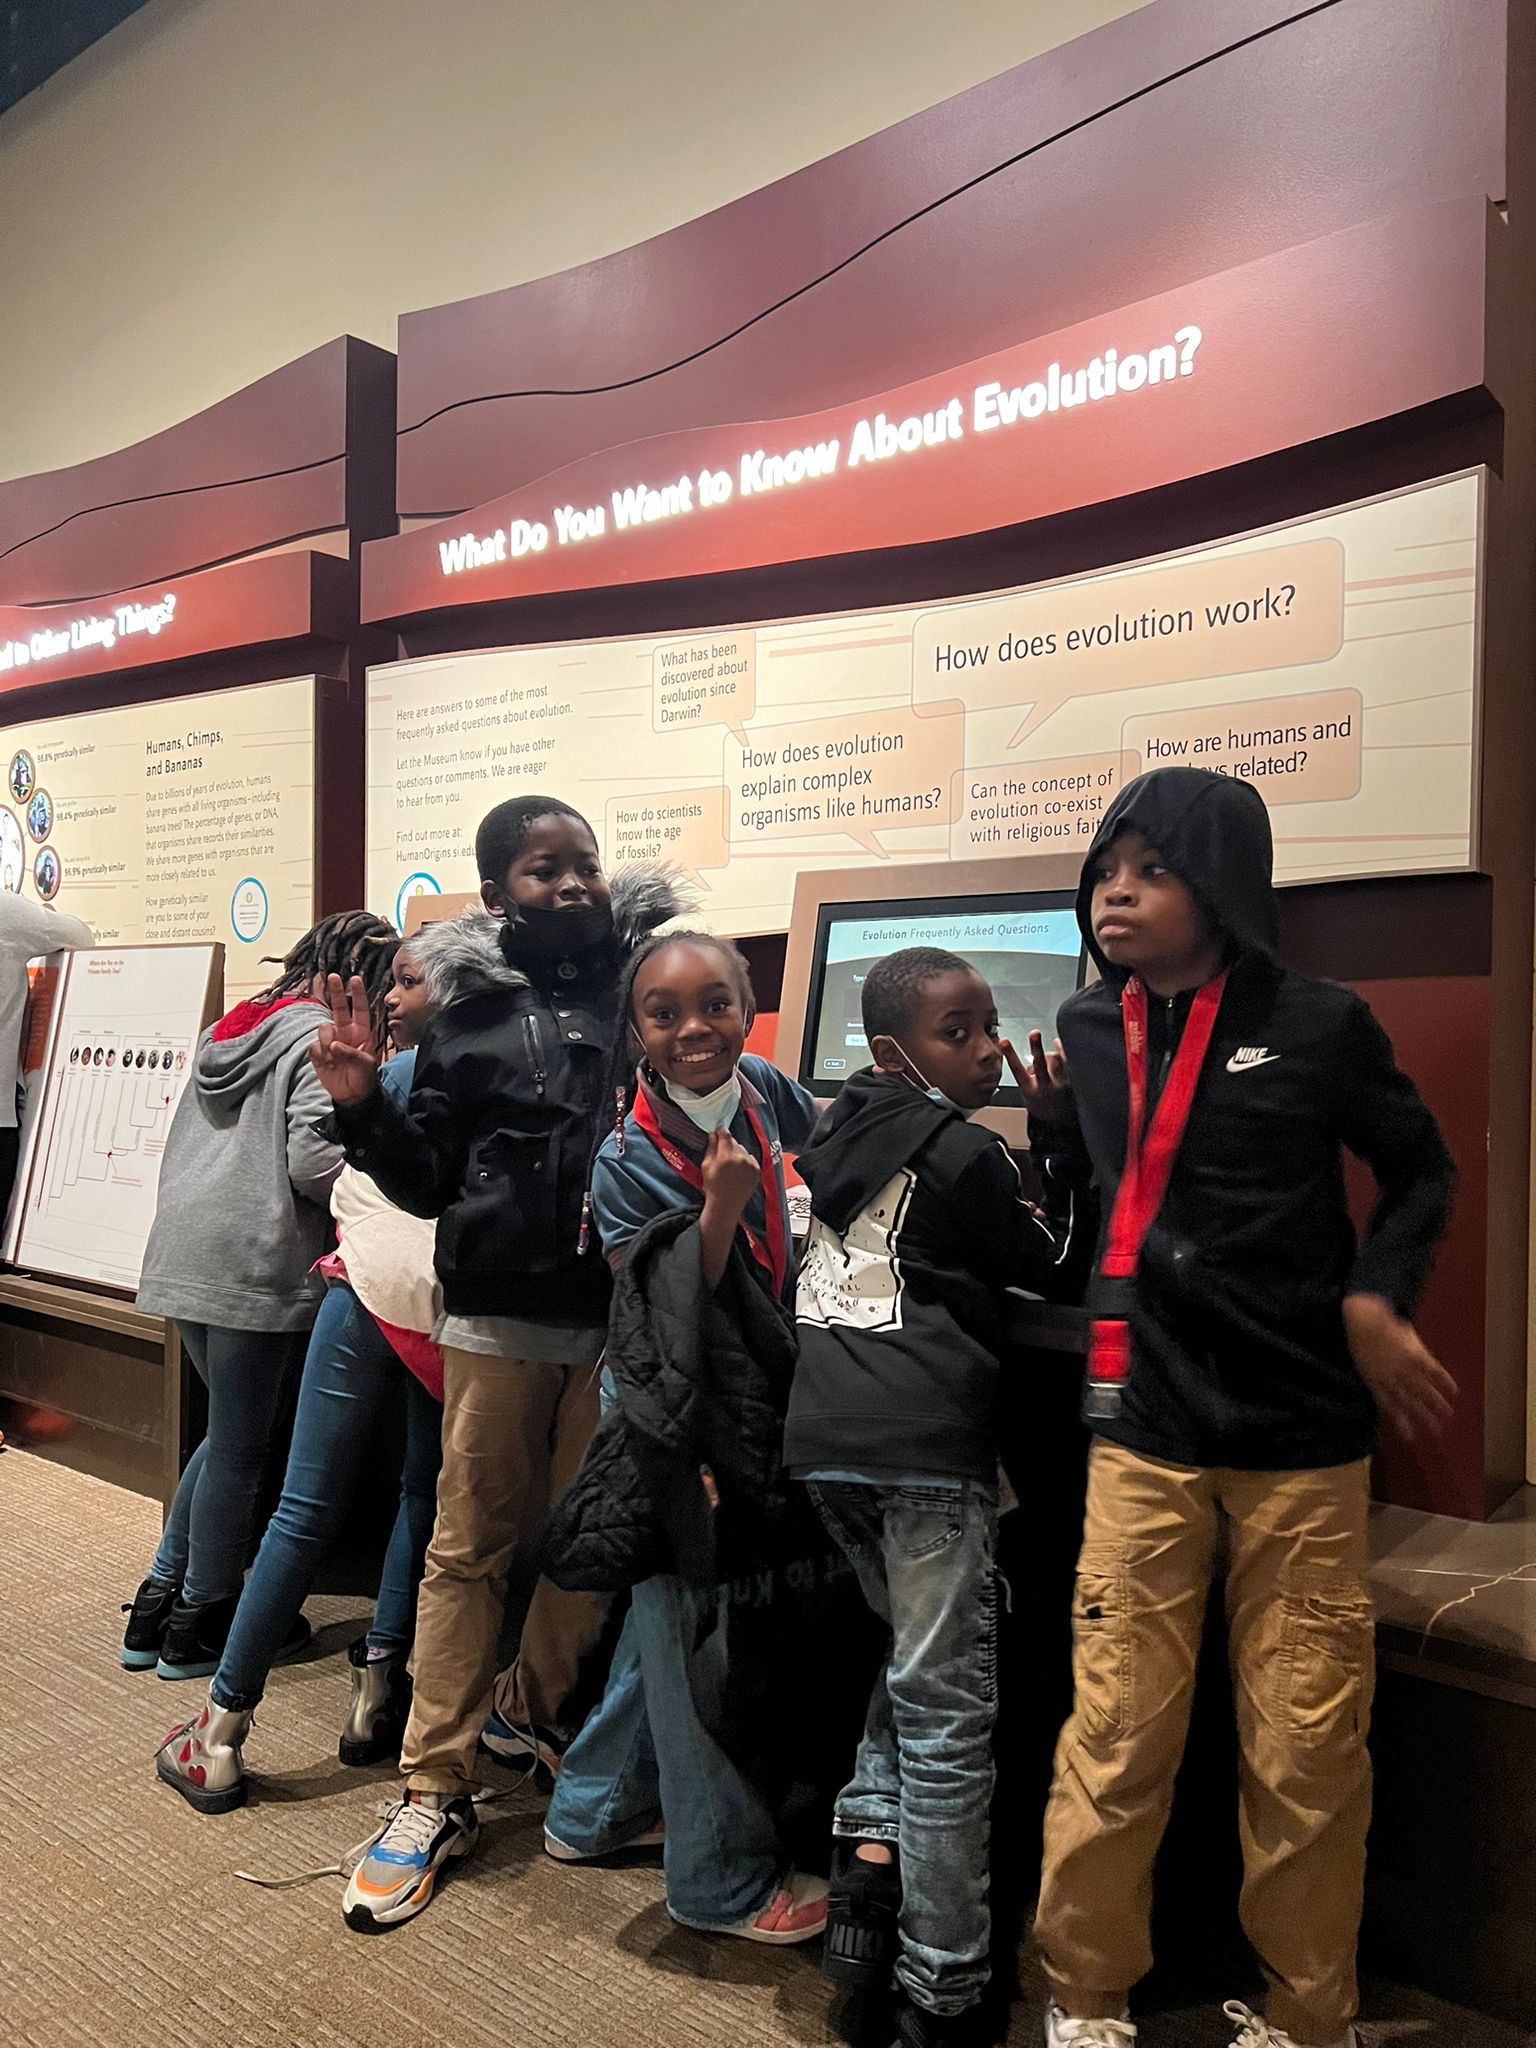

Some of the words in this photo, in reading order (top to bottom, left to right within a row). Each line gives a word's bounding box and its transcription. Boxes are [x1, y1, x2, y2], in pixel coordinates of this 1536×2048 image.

[438, 528, 506, 575] What
[510, 518, 548, 557] Do
[553, 504, 605, 544] You
[611, 475, 692, 529] Want
[698, 467, 732, 507] to
[740, 439, 839, 497] Know
[848, 398, 963, 467] About
[974, 325, 1202, 432] Evolution?
[116, 593, 177, 635] Things?
[936, 644, 989, 672] How
[998, 633, 1056, 662] does
[1067, 609, 1192, 650] evolution
[1205, 585, 1295, 628] work?
[661, 652, 688, 667] What
[691, 648, 708, 662] has
[712, 644, 736, 658] been
[661, 663, 714, 686] discovered
[717, 659, 748, 677] about
[397, 709, 414, 722] Here
[416, 708, 428, 718] are
[430, 702, 463, 715] answers
[465, 699, 473, 710] to
[475, 695, 497, 708] some
[500, 689, 508, 703] of
[510, 689, 524, 702] the
[526, 685, 548, 699] most
[661, 686, 706, 704] evolution
[710, 682, 736, 697] since
[397, 727, 434, 742] frequently
[436, 719, 459, 734] asked
[461, 715, 500, 732] questions
[503, 710, 528, 724] about
[530, 703, 573, 719] evolution.
[662, 704, 702, 723] Darwin?
[146, 739, 184, 755] Humans,
[187, 731, 223, 747] Chimps,
[1148, 738, 1188, 758] How
[1194, 736, 1222, 753] are
[1228, 727, 1306, 749] humans
[1313, 715, 1350, 740] and
[397, 758, 408, 770] Let
[409, 756, 422, 768] the
[424, 753, 458, 766] Museum
[460, 749, 482, 761] know
[485, 745, 490, 758] if
[492, 746, 507, 760] you
[510, 742, 530, 754] have
[532, 737, 555, 751] other
[743, 749, 776, 768] How
[782, 743, 819, 764] does
[826, 732, 903, 758] evolution
[146, 760, 162, 776] and
[165, 757, 202, 773] Bananas
[396, 775, 433, 792] questions
[434, 775, 444, 784] or
[445, 768, 489, 783] comments.
[491, 764, 505, 777] We
[508, 765, 521, 775] are
[523, 761, 547, 775] eager
[1234, 751, 1307, 778] related?
[742, 774, 796, 801] explain
[803, 765, 872, 793] complex
[971, 783, 996, 799] Can
[1004, 779, 1026, 796] the
[1032, 773, 1092, 793] concept
[1098, 768, 1114, 786] of
[396, 798, 404, 808] to
[406, 795, 423, 807] hear
[425, 793, 443, 805] from
[445, 793, 462, 806] you.
[617, 810, 638, 824] How
[641, 808, 654, 821] do
[657, 803, 702, 820] scientists
[741, 803, 820, 830] organisms
[827, 797, 855, 818] like
[862, 787, 941, 815] humans?
[971, 801, 1038, 821] evolution
[1044, 795, 1102, 814] co-exist
[396, 829, 413, 844] Find
[415, 830, 428, 841] out
[430, 829, 450, 840] more
[452, 827, 462, 838] at:
[616, 828, 642, 841] know
[646, 825, 661, 839] the
[664, 827, 681, 841] age
[970, 825, 1000, 842] with
[1008, 822, 1070, 842] religious
[1077, 817, 1102, 835] fait
[616, 846, 626, 860] of
[628, 843, 661, 863] fossils?
[862, 929, 907, 940] Evolution
[910, 926, 962, 940] Frequently
[964, 924, 994, 936] Asked
[998, 921, 1050, 937] Questions
[1234, 1046, 1269, 1063] NIKE
